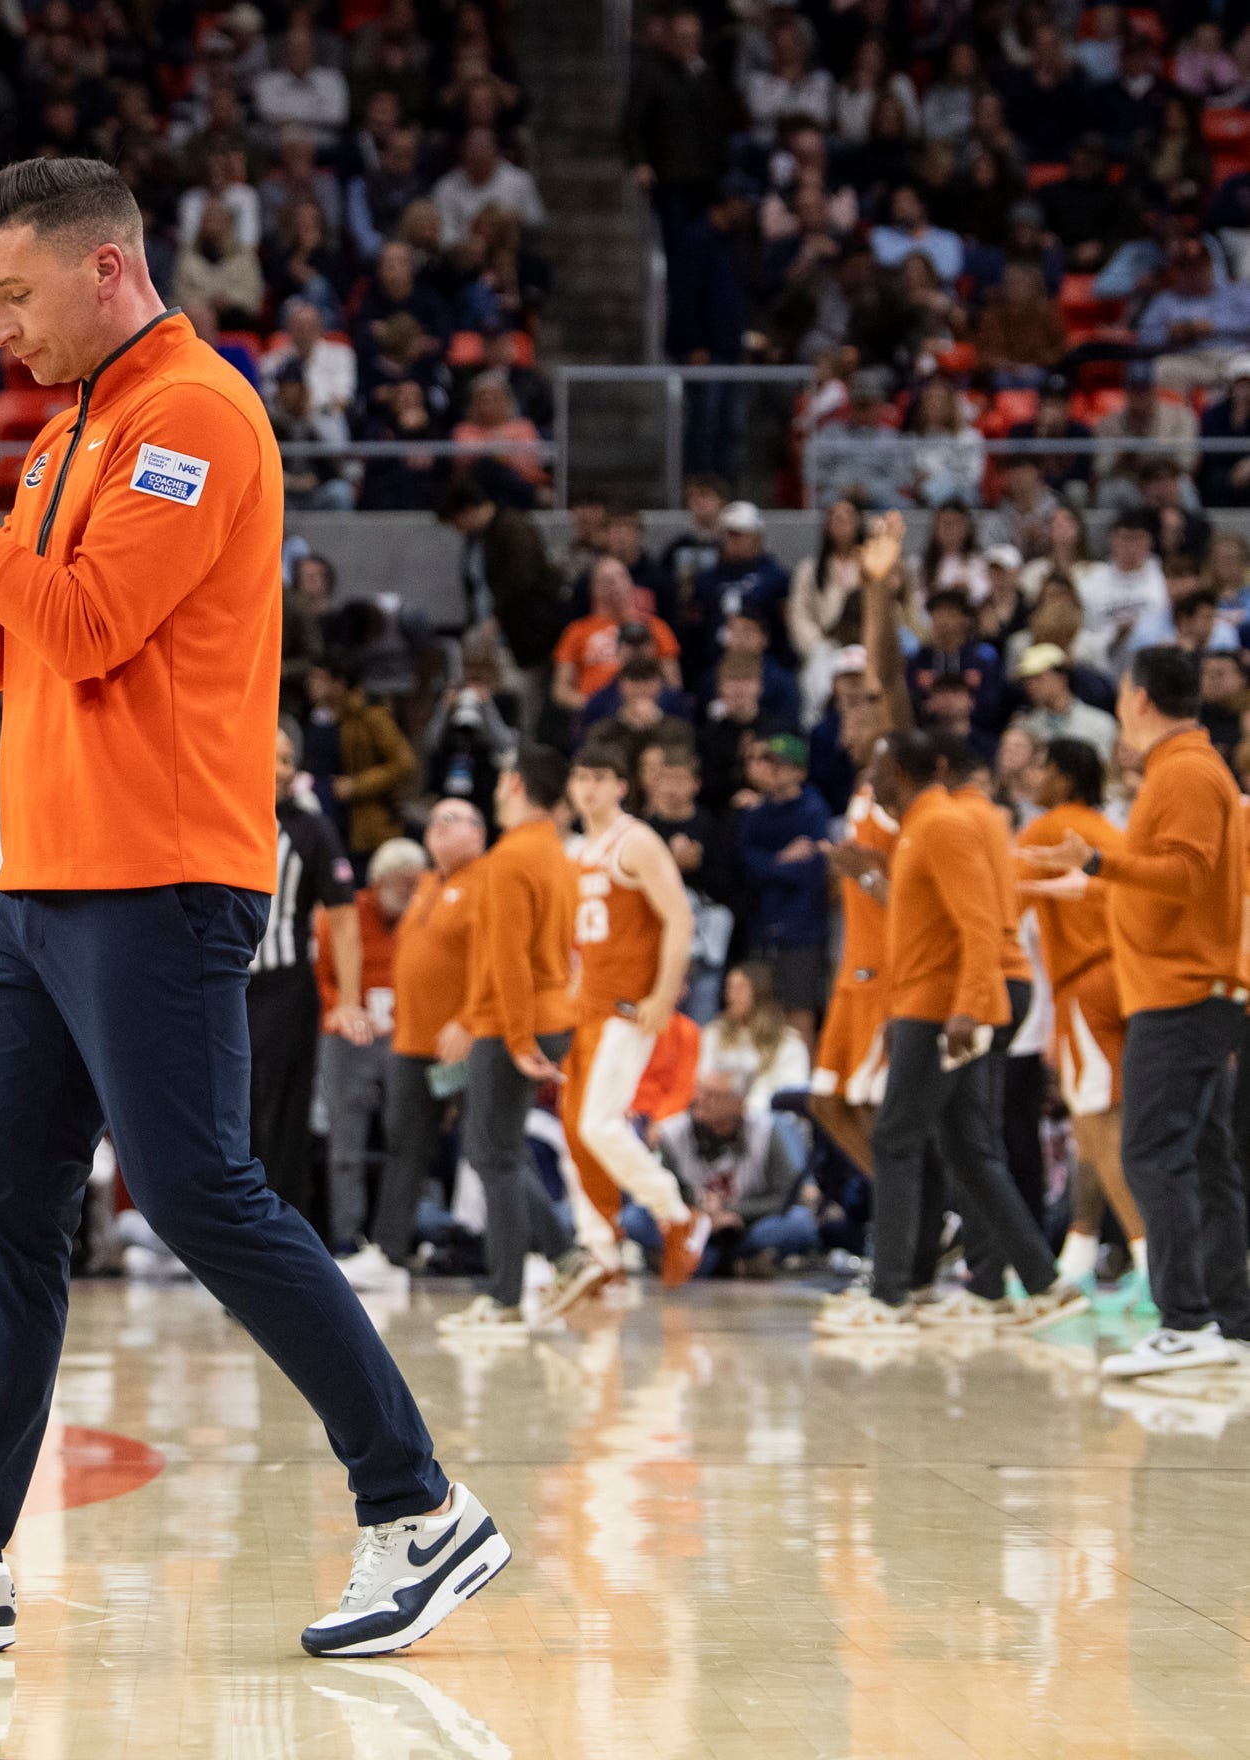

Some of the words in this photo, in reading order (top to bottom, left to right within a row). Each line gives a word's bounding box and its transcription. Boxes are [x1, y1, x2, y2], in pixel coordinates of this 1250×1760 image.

[149, 452, 172, 462] American
[178, 462, 202, 477] NABC
[149, 474, 189, 491] COACHES
[152, 483, 187, 499] CANCER
